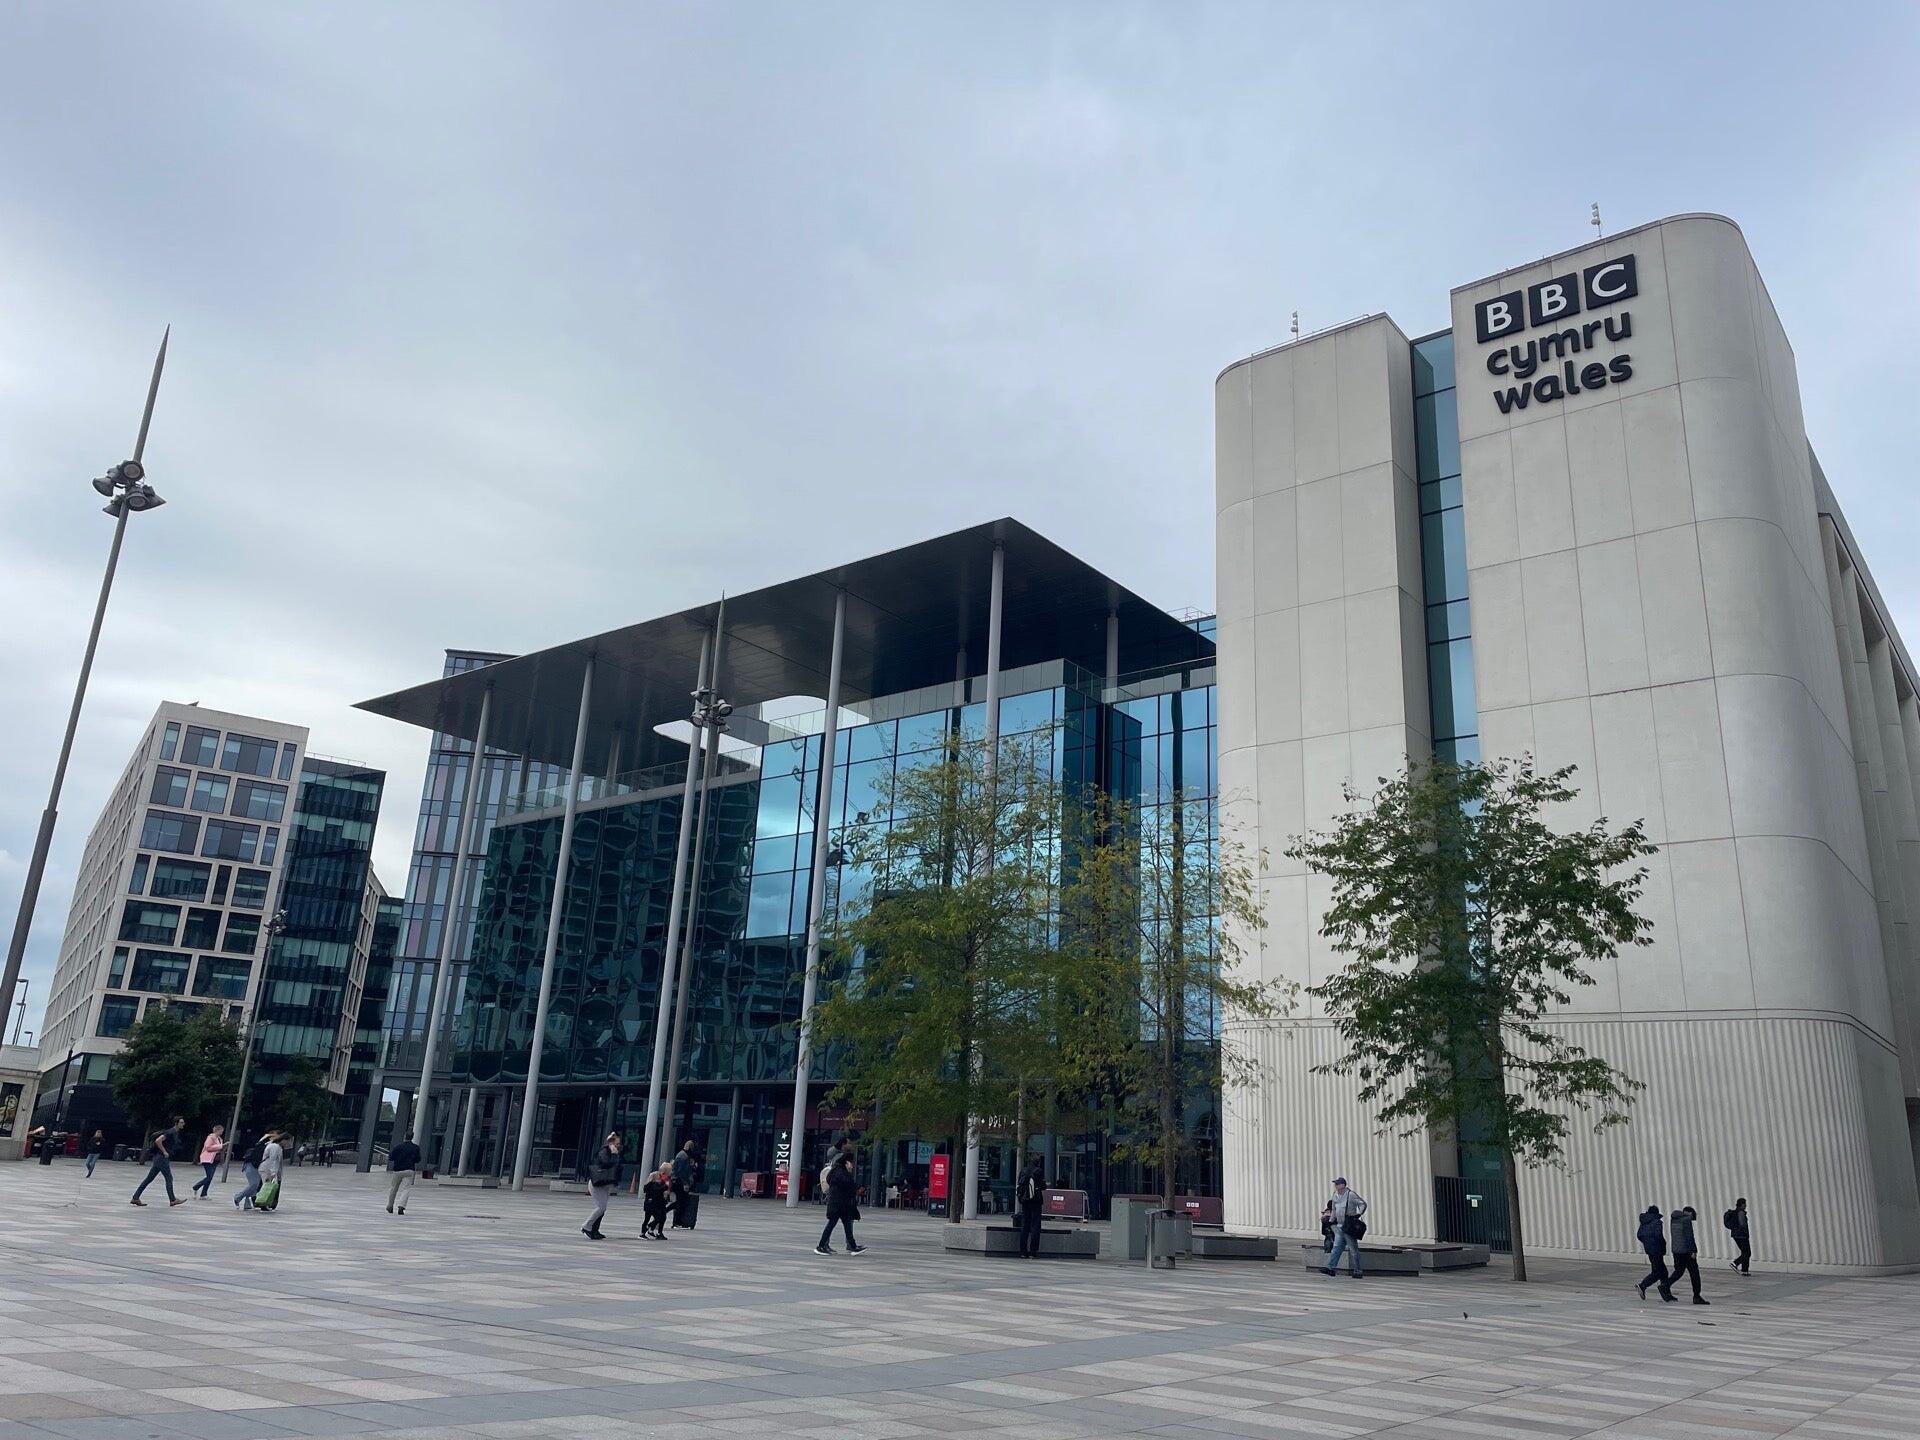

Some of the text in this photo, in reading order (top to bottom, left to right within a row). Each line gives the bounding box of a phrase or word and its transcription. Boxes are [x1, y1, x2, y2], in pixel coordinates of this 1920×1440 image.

[1485, 263, 1628, 334] BBC
[1486, 311, 1632, 379] cymru
[1492, 354, 1633, 414] wales
